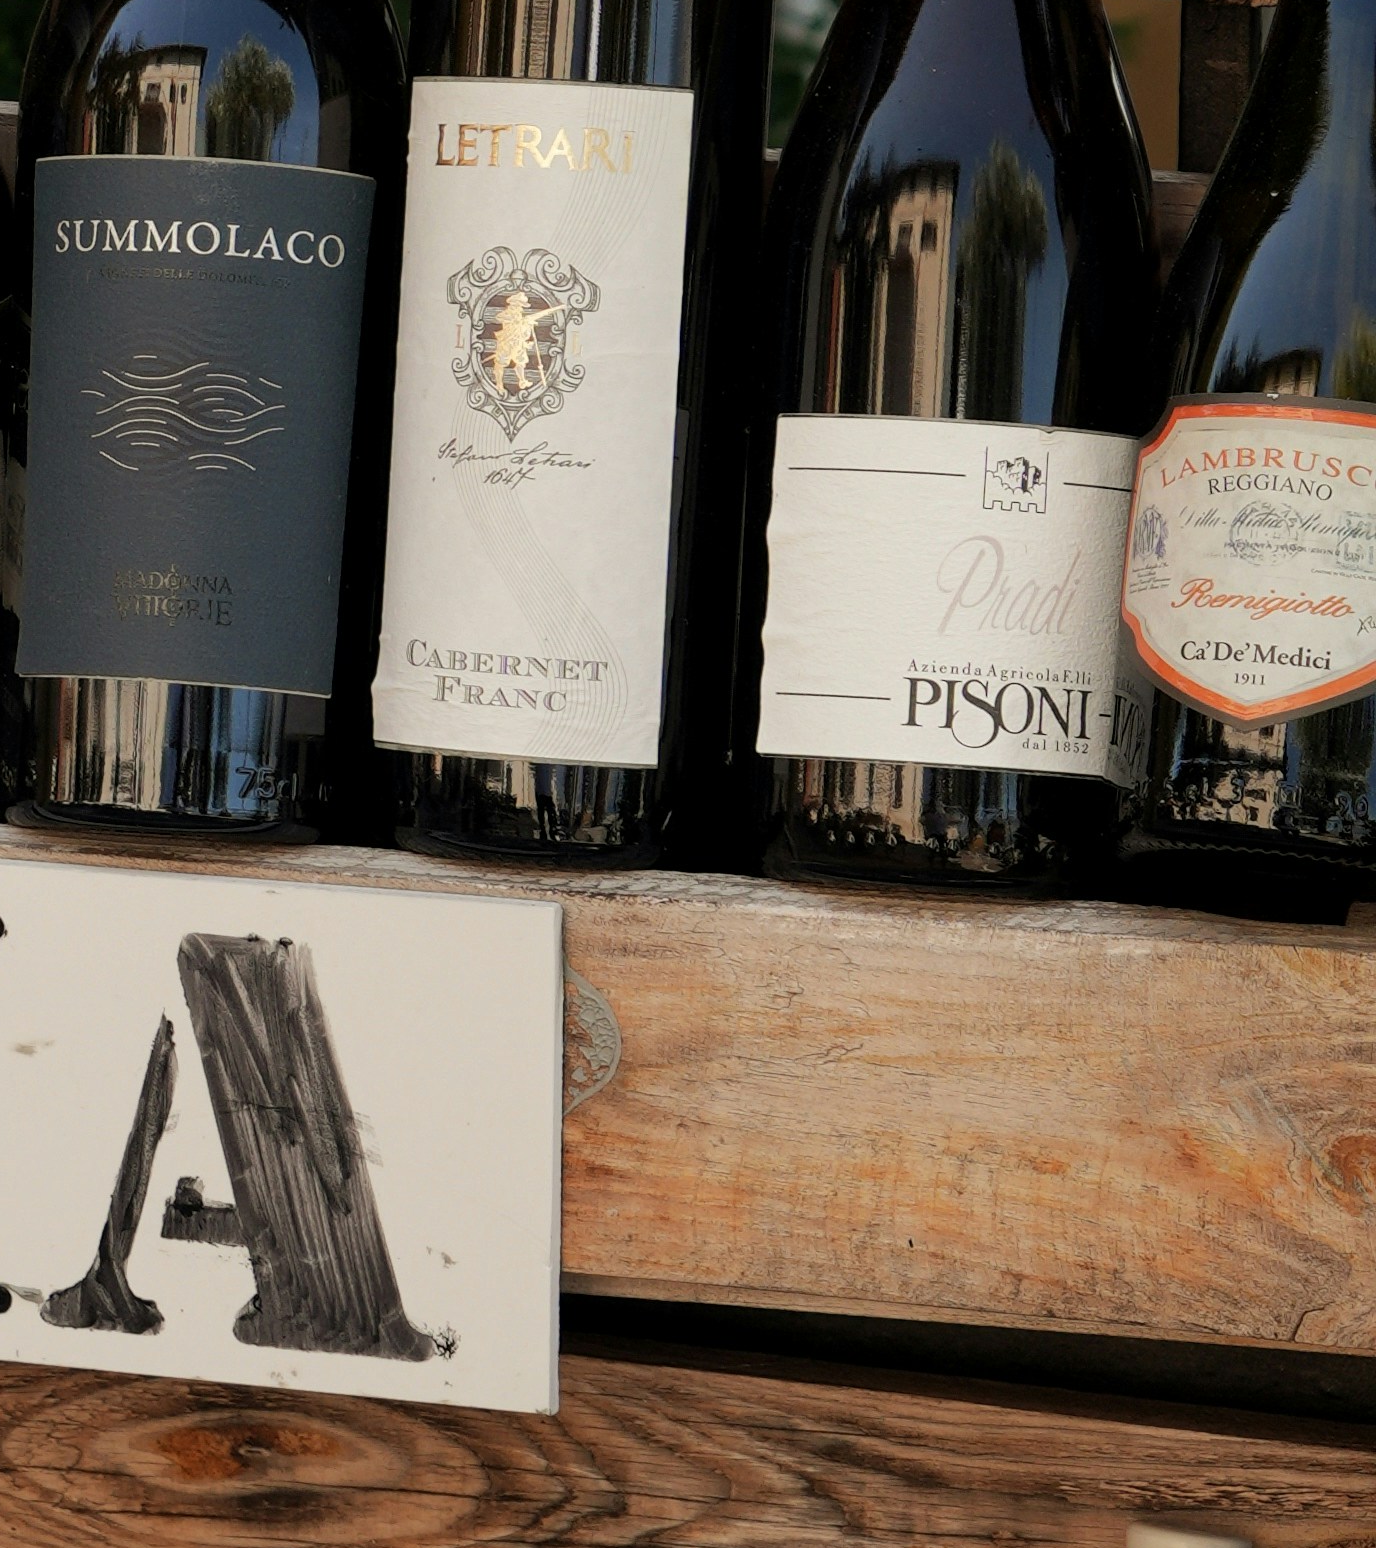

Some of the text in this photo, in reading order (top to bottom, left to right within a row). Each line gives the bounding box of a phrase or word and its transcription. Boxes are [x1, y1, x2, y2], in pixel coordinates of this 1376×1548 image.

[434, 123, 637, 174] LETRARI
[54, 217, 346, 269] SUMMOLACO
[1207, 473, 1333, 502] REGGIANO
[1170, 577, 1356, 621] Remigiotto
[404, 638, 609, 683] CABERNET
[907, 658, 1060, 685] Azienda Agricola
[1233, 672, 1266, 686] 1911
[432, 673, 569, 713] FRANC
[900, 675, 1093, 749] PISONI
[1021, 737, 1091, 755] dal 1852
